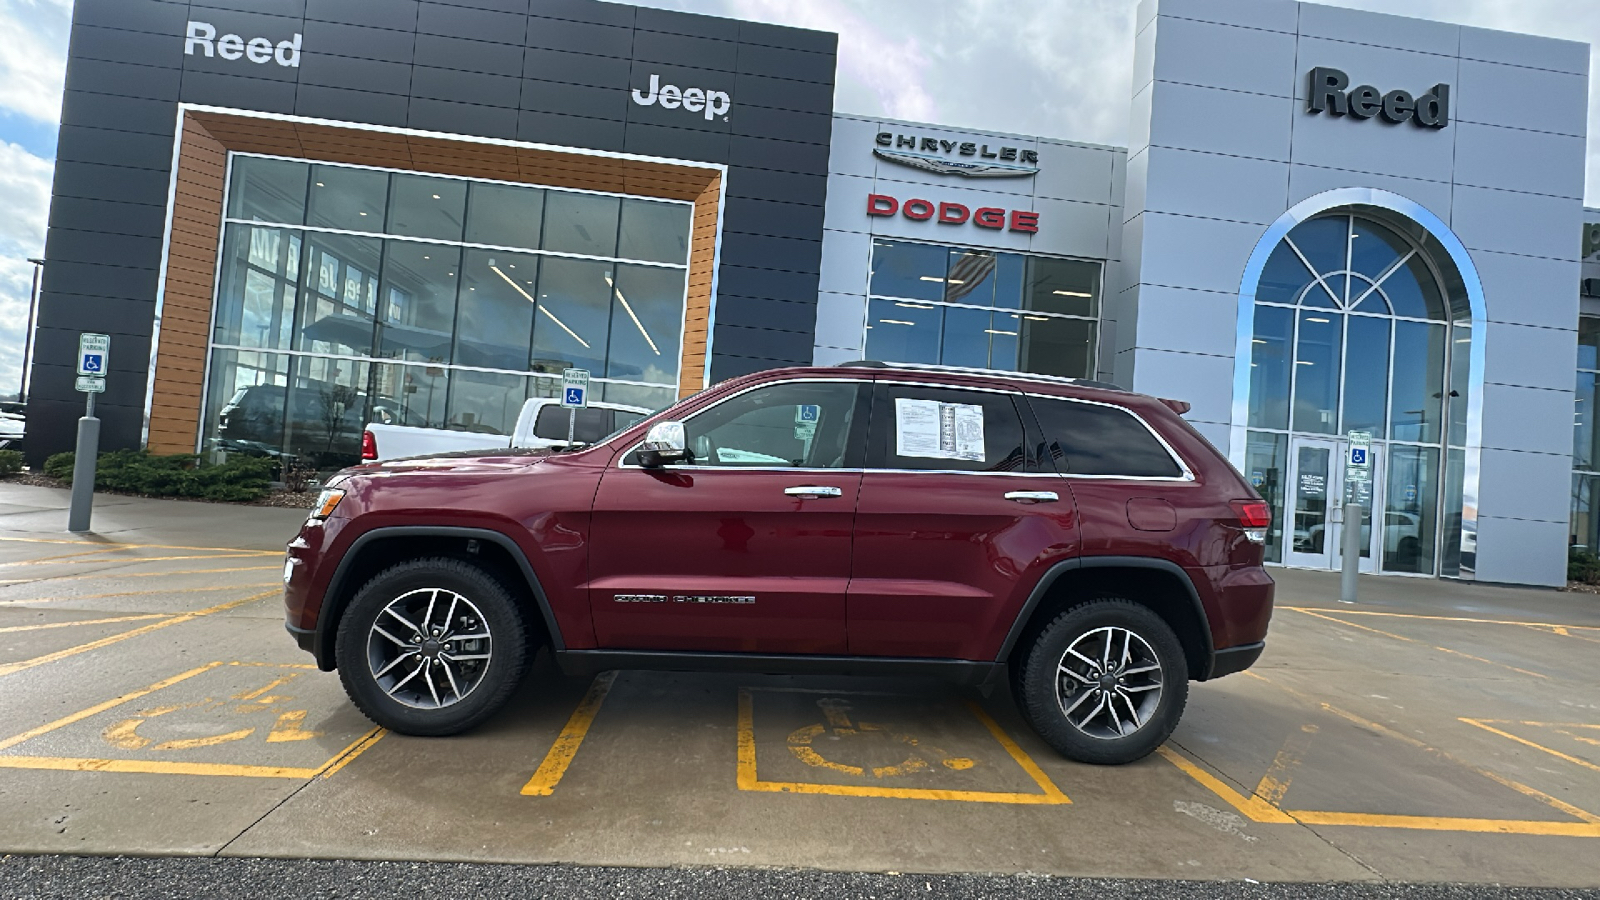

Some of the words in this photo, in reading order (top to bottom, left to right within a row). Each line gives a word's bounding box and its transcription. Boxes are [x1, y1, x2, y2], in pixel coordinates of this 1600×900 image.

[184, 20, 303, 68] Reed
[632, 74, 731, 121] Jeep
[1307, 66, 1450, 130] Reed
[876, 132, 1039, 163] CHRYSLER
[867, 193, 1040, 234] DODGE
[614, 594, 668, 603] GRAND
[673, 595, 756, 604] CHEROKEE
